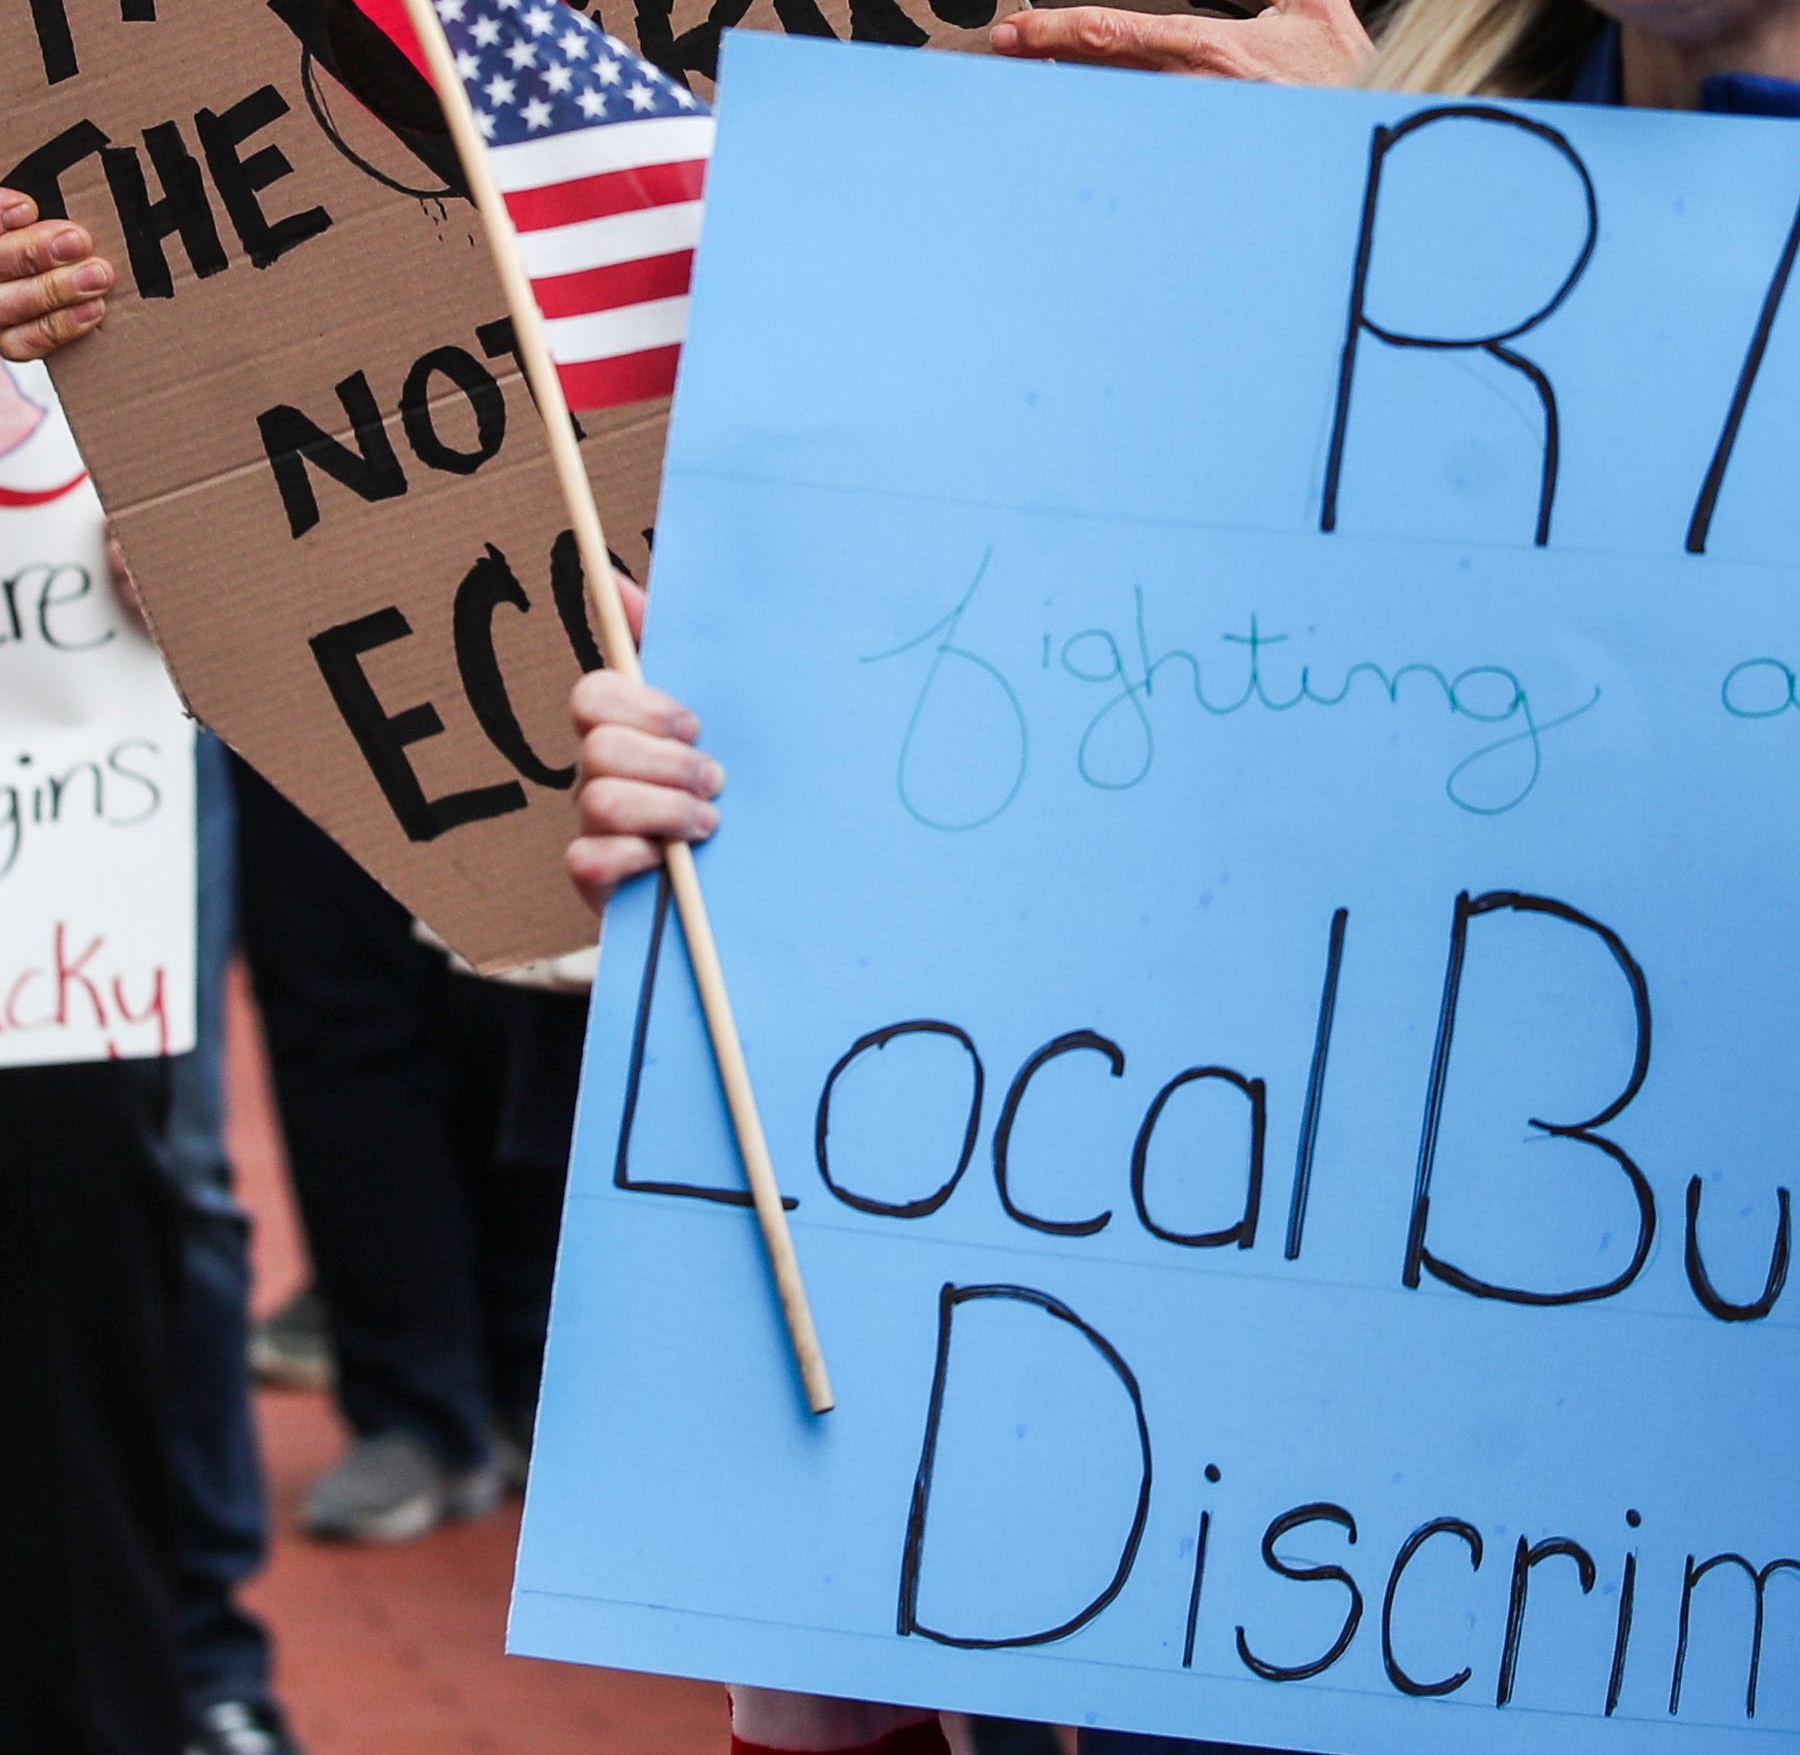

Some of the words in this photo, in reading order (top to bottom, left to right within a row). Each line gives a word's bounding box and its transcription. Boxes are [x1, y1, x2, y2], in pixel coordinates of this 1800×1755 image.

[0, 82, 334, 300] THE
[862, 546, 1604, 832] fighting
[612, 869, 1350, 1263] Local
